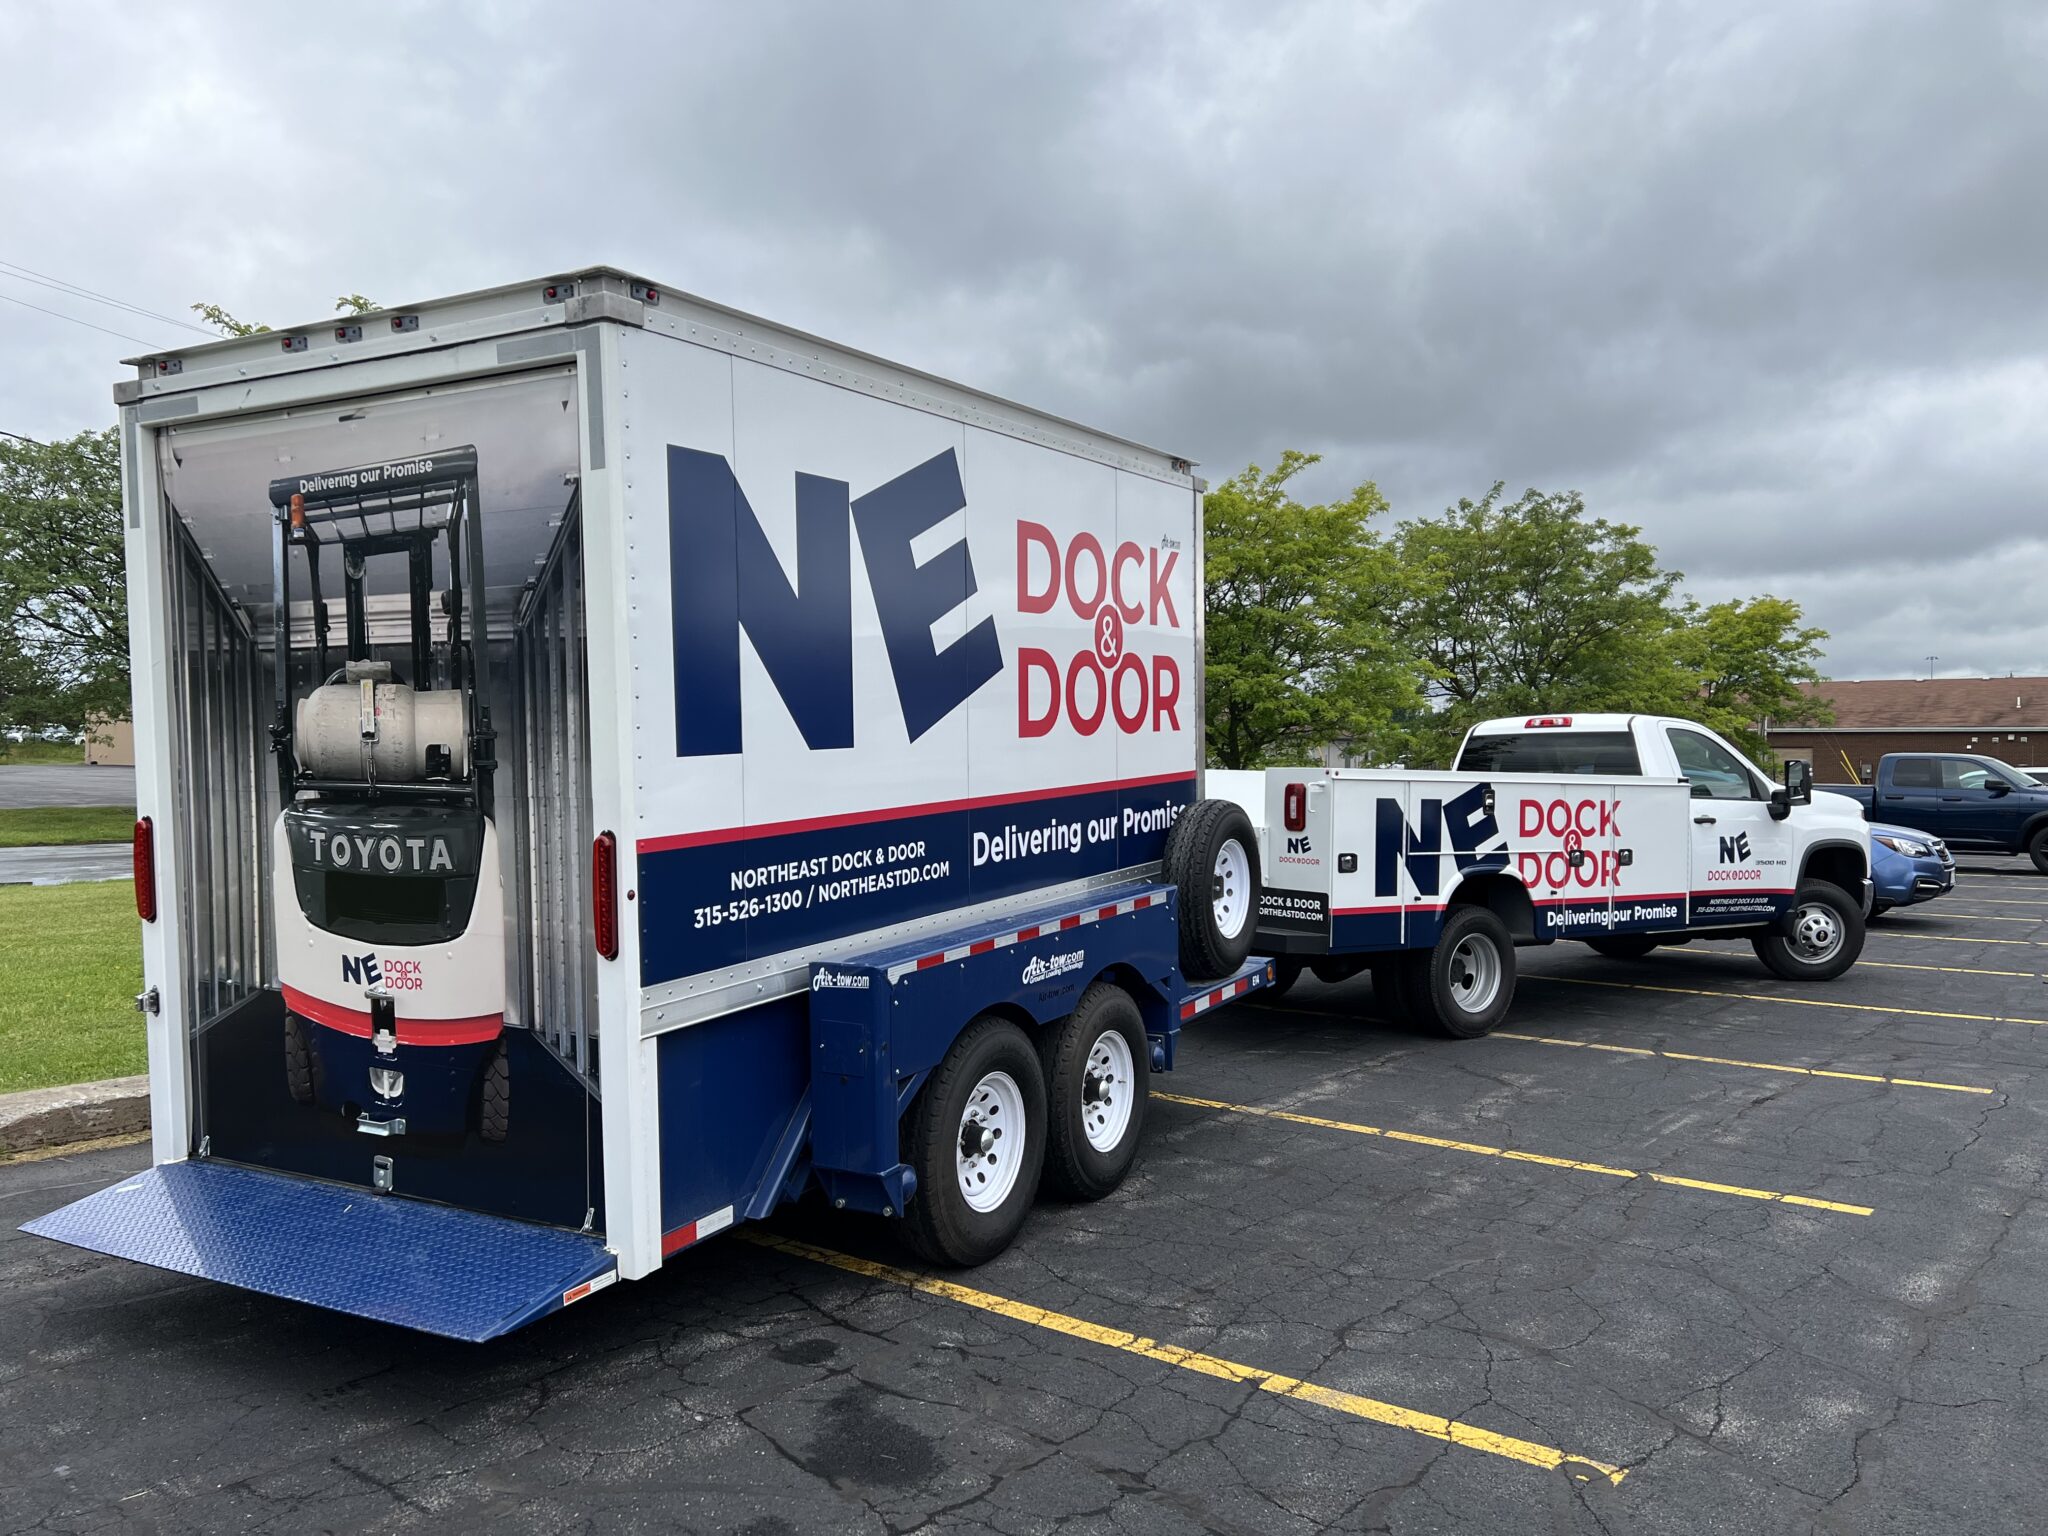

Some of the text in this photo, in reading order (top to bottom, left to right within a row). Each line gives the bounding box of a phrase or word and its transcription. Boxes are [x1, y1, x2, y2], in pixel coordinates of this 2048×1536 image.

[300, 460, 433, 493] Delivering our Promise
[1017, 519, 1180, 628] DOCK
[667, 444, 1003, 757] NE
[1018, 647, 1180, 738] DOOR
[973, 800, 1185, 866] Delivering our Promis
[1519, 799, 1621, 837] DOCK
[310, 831, 453, 871] TOYOTA
[1287, 836, 1311, 854] NE
[1376, 782, 1510, 897] NE
[1719, 831, 1752, 864] NE
[731, 841, 926, 891] NORTHEAST DOCK & DOOR
[1518, 850, 1621, 889] DOOR
[694, 861, 950, 928] 315-526-1300 / NORTHEASTDD.COM
[1286, 898, 1292, 906] &
[1294, 899, 1320, 910] DOOR
[1547, 904, 1677, 927] Delivering our Promise
[342, 952, 383, 985] NE
[384, 960, 421, 974] DOCK
[385, 976, 423, 990] DOOR
[813, 967, 870, 991] Air-tow.com
[1022, 950, 1084, 984] Air-tow.com
